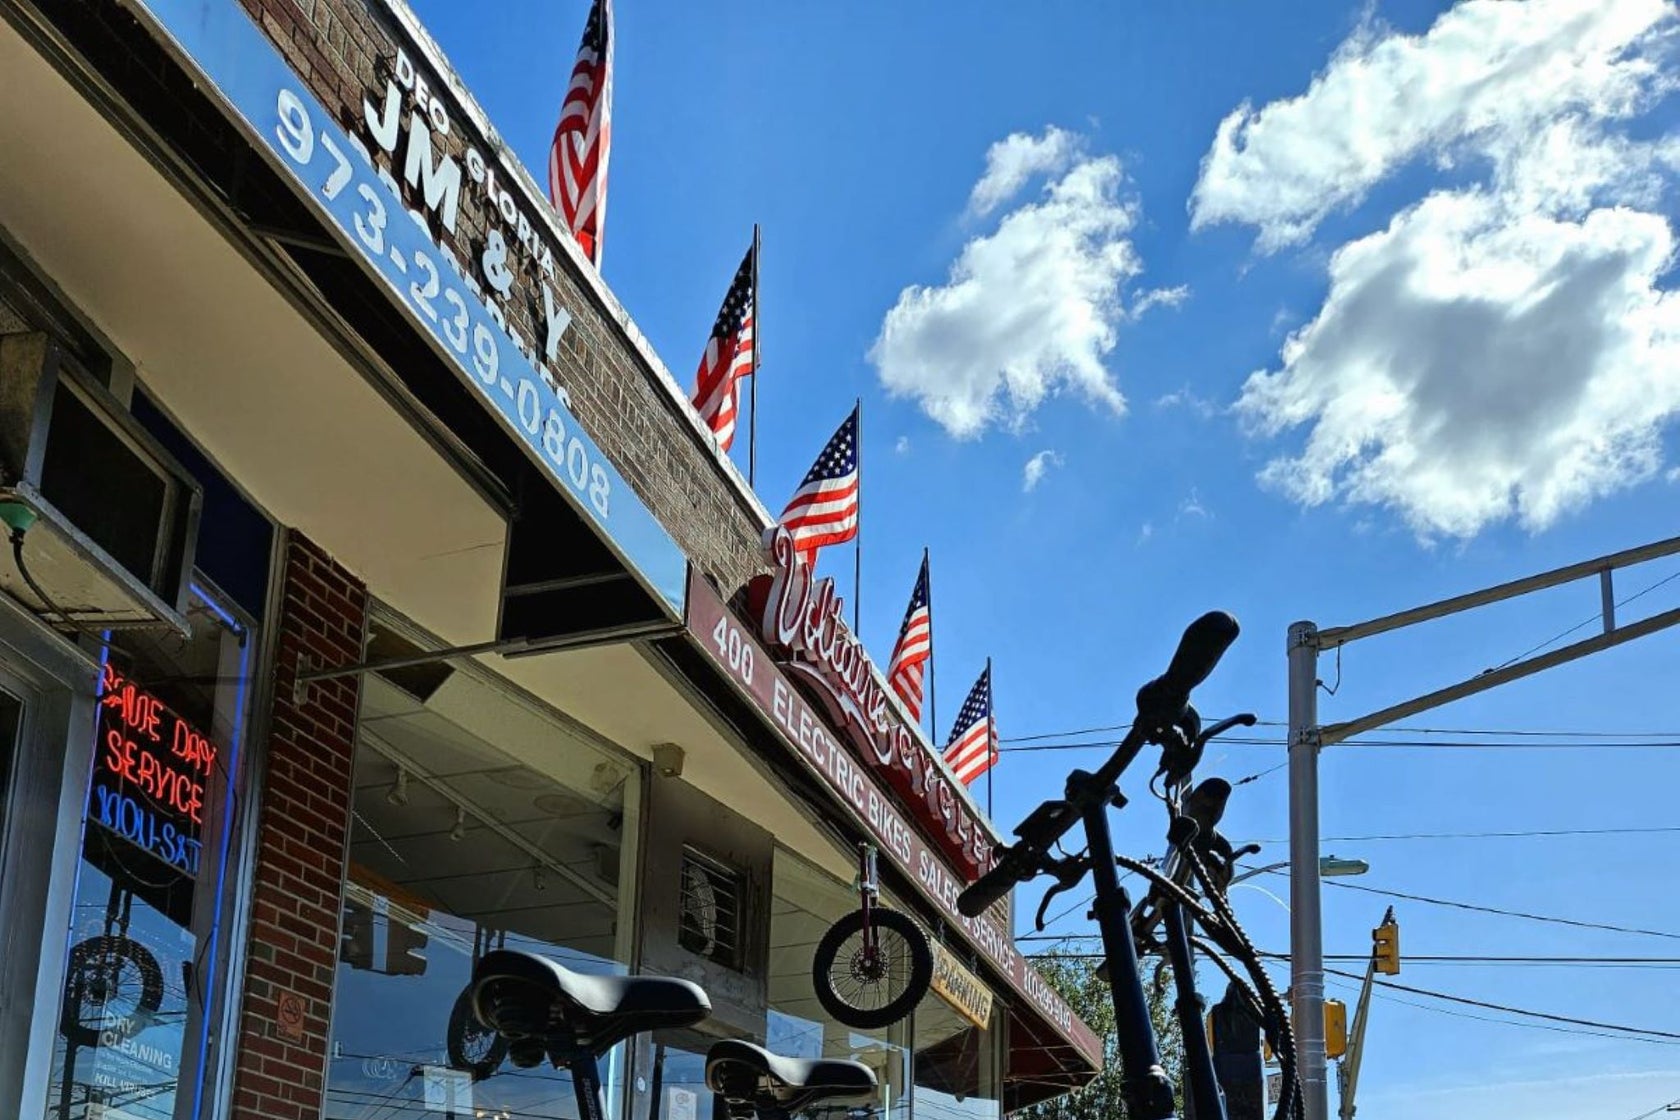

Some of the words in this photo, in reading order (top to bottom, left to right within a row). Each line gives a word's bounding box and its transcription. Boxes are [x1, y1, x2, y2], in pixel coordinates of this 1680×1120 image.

[363, 79, 462, 236] JM
[482, 229, 514, 301] &
[542, 282, 572, 363] Y
[395, 47, 449, 135] DEO
[467, 148, 555, 281] GLORIA
[276, 89, 611, 519] 973-239-0808
[107, 730, 204, 824] SERVICE
[172, 720, 217, 776] DAY
[712, 615, 755, 686] 400
[773, 677, 864, 807] ELECTRIC
[868, 791, 912, 864] BIKES
[919, 851, 960, 917] SALES
[973, 916, 1015, 976] SERVICE
[102, 1032, 172, 1069] CLEANING
[104, 1010, 135, 1035] DRY
